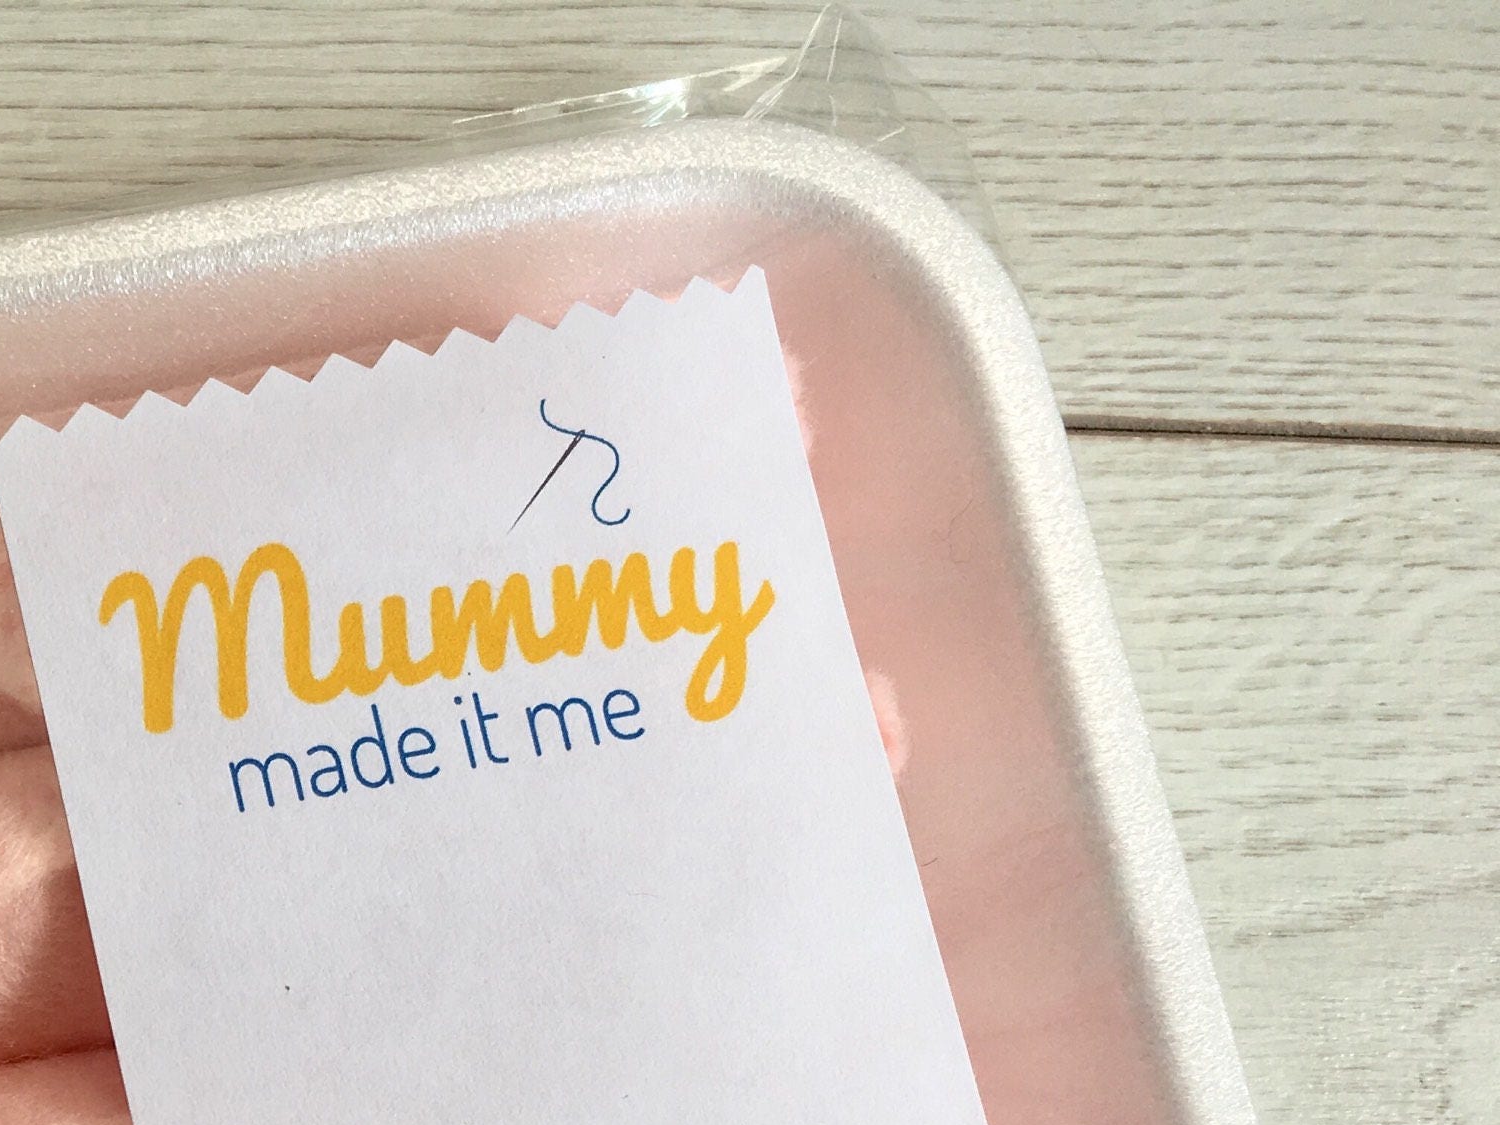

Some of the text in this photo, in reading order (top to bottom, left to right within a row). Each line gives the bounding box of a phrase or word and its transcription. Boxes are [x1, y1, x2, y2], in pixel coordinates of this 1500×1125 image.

[99, 541, 776, 734] Mummy
[228, 688, 646, 814] made it me
